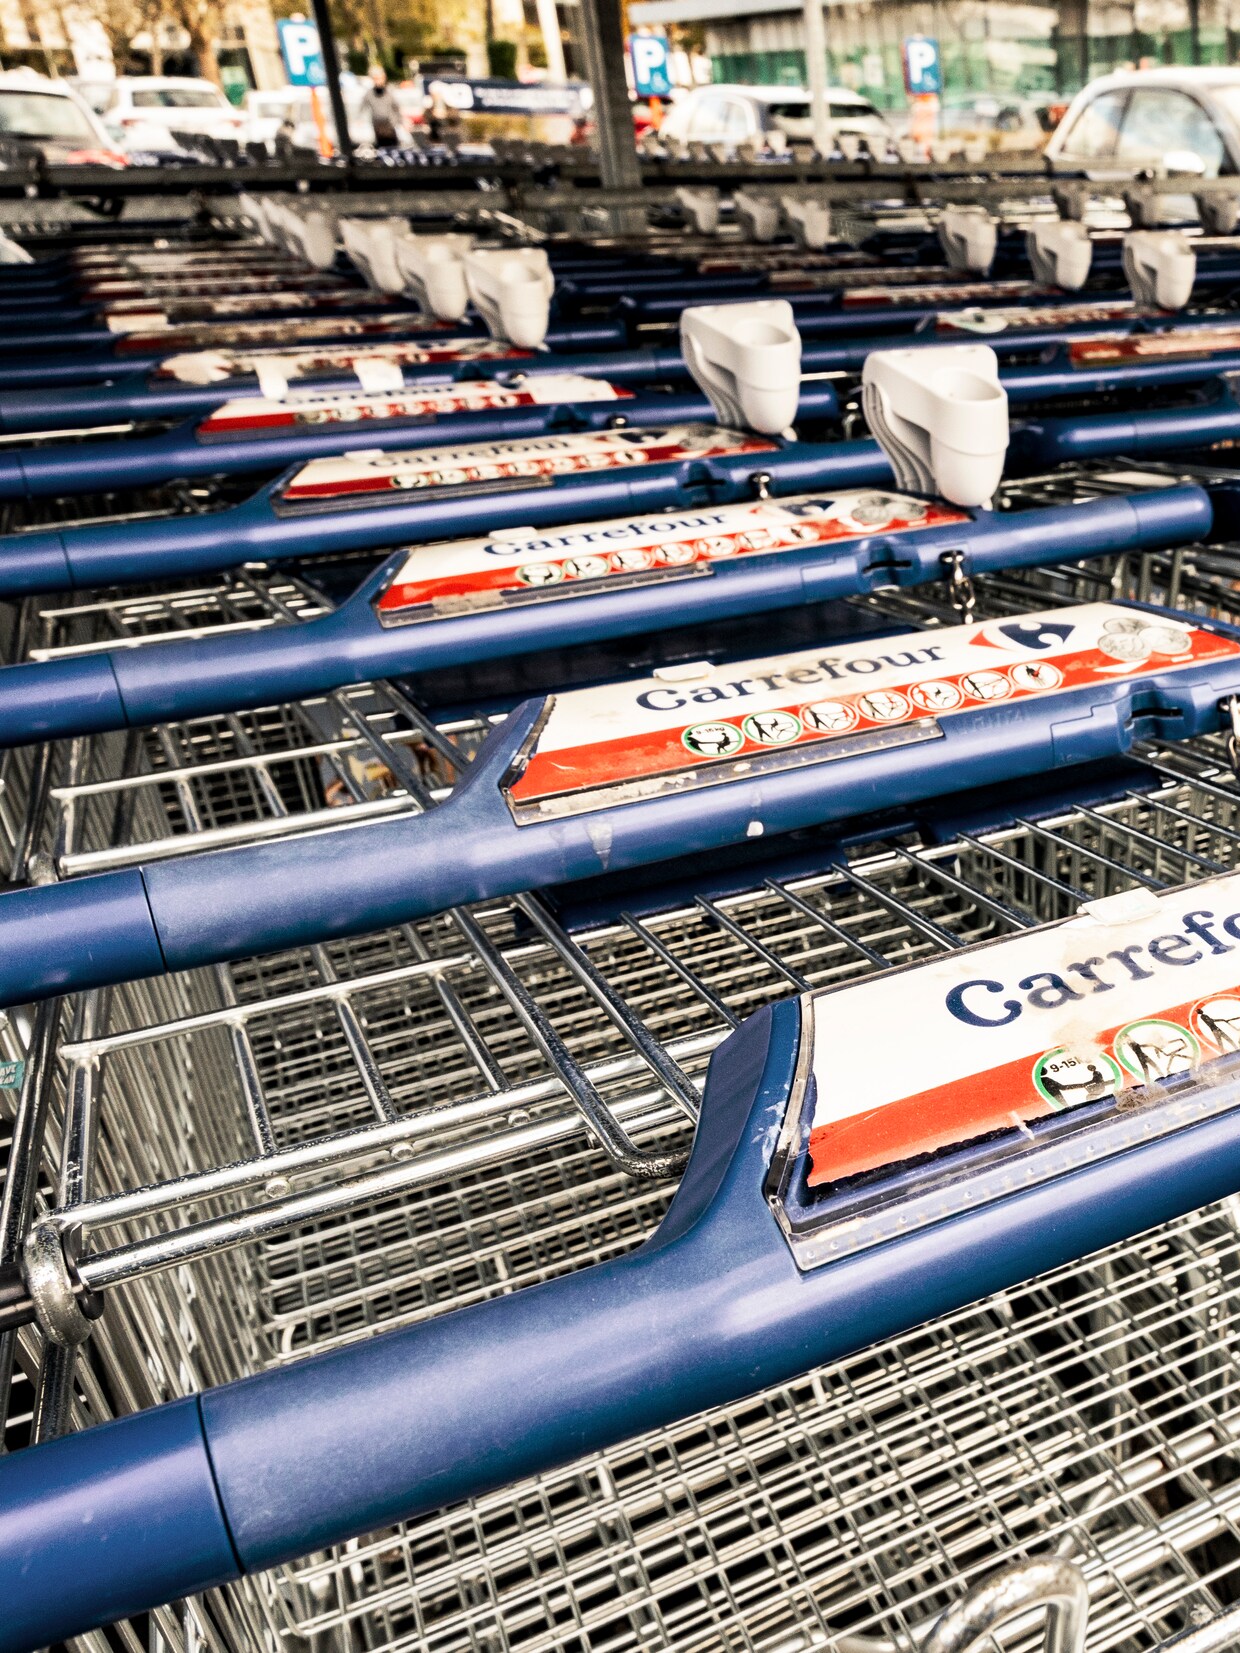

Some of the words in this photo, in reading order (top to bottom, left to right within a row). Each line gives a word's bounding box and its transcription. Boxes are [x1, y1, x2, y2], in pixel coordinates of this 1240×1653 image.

[282, 23, 320, 76] P
[632, 35, 666, 84] P
[907, 41, 936, 84] P
[483, 513, 727, 556] Carrefour
[636, 646, 946, 711] Carrefour
